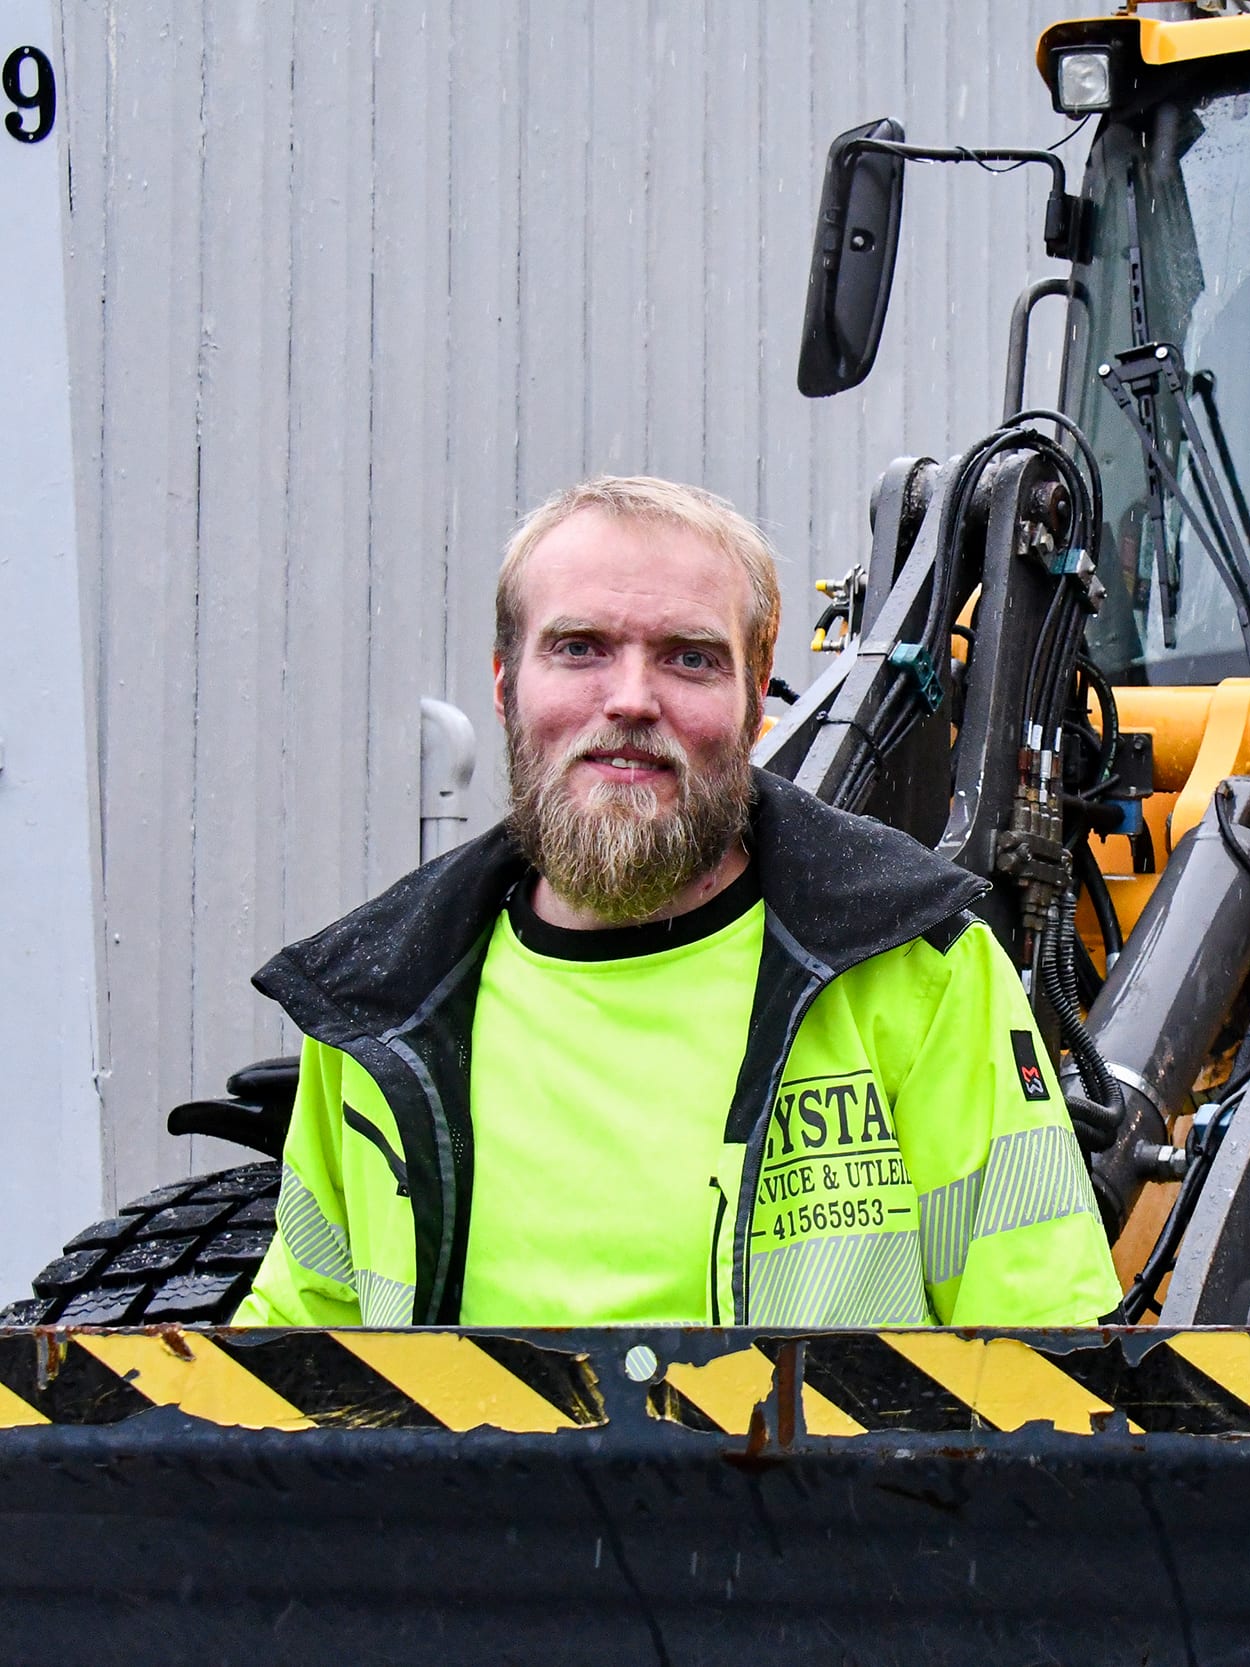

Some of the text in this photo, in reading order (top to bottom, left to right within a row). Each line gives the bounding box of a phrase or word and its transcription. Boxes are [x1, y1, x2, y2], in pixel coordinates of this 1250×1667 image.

[2, 45, 56, 143] 9
[767, 1082, 897, 1159] YSTA
[823, 1164, 840, 1190] &
[773, 1198, 884, 1240] 41565953
